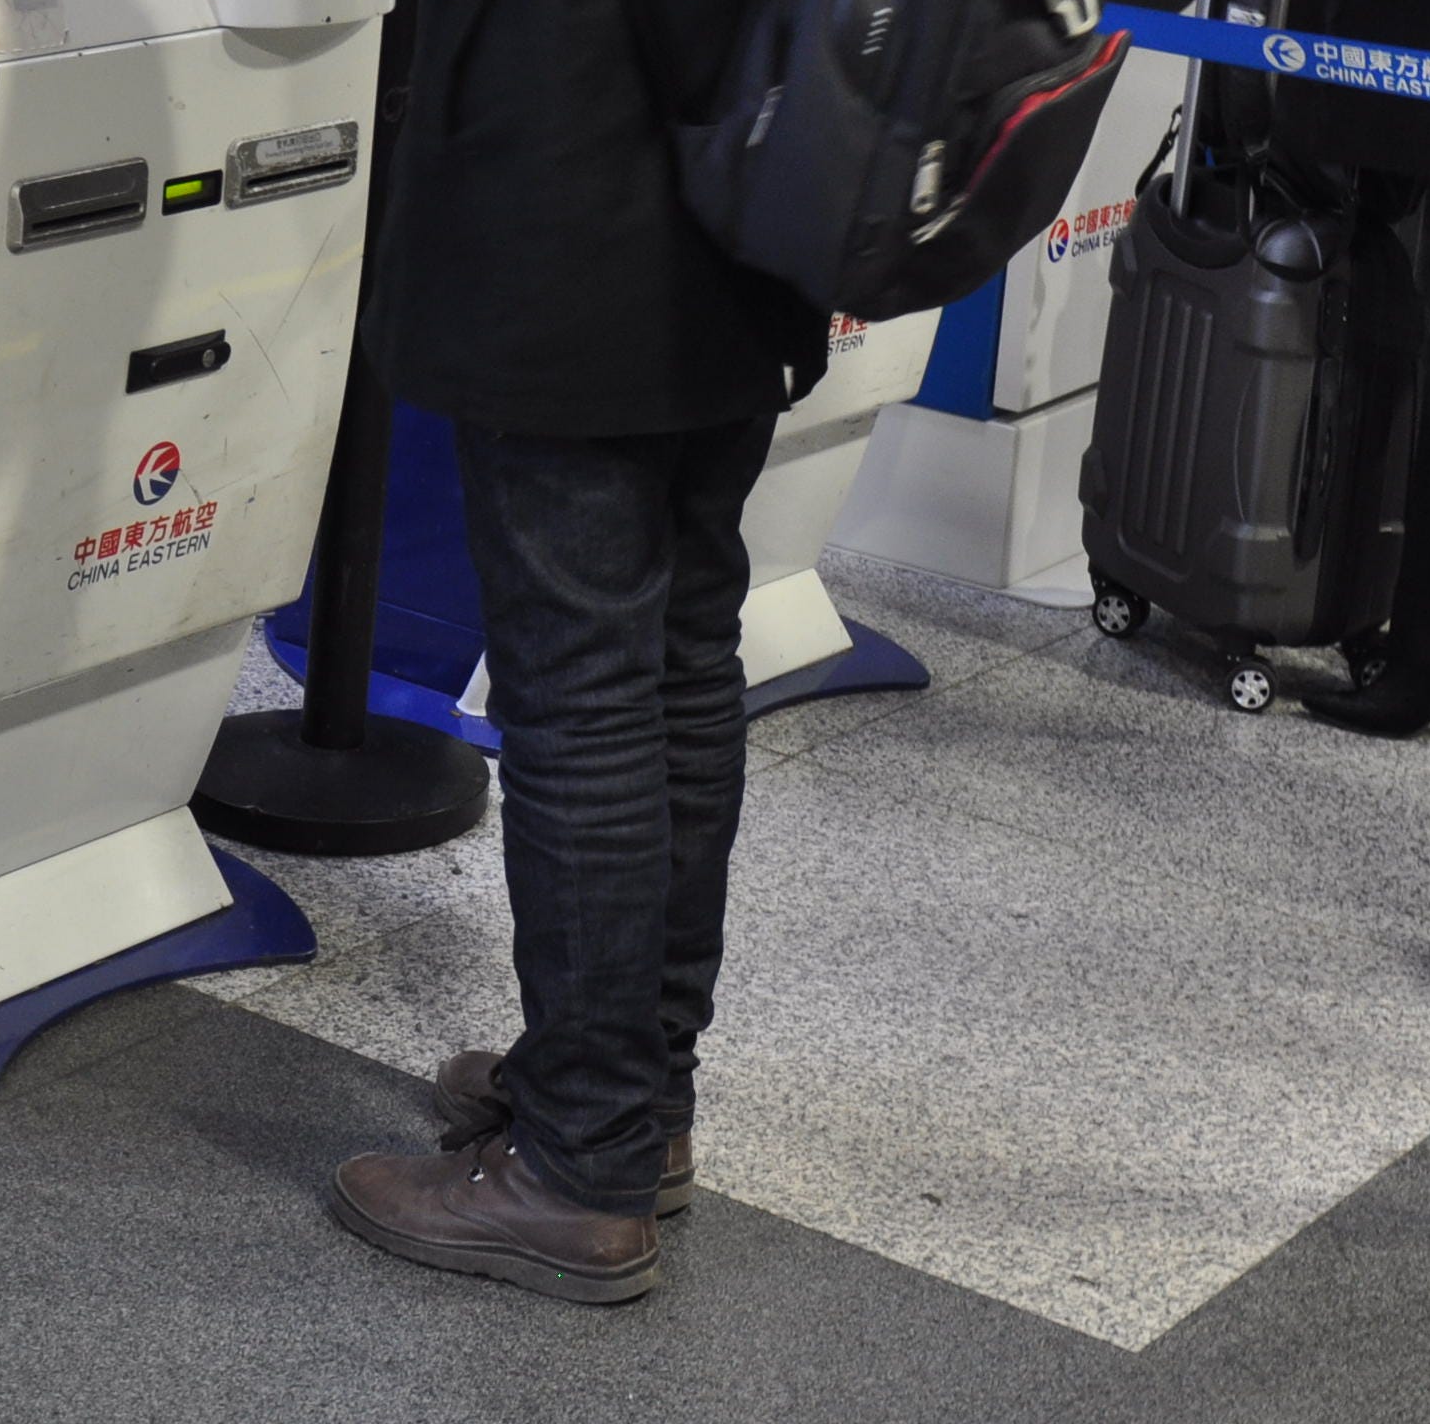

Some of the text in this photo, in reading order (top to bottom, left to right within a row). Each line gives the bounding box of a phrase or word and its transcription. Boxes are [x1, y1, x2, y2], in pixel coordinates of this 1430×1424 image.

[1315, 63, 1377, 87] CHINA
[1072, 235, 1100, 257] CHINA
[74, 501, 218, 566] 中國東方航空
[68, 531, 212, 591] CHINA EASTERN
